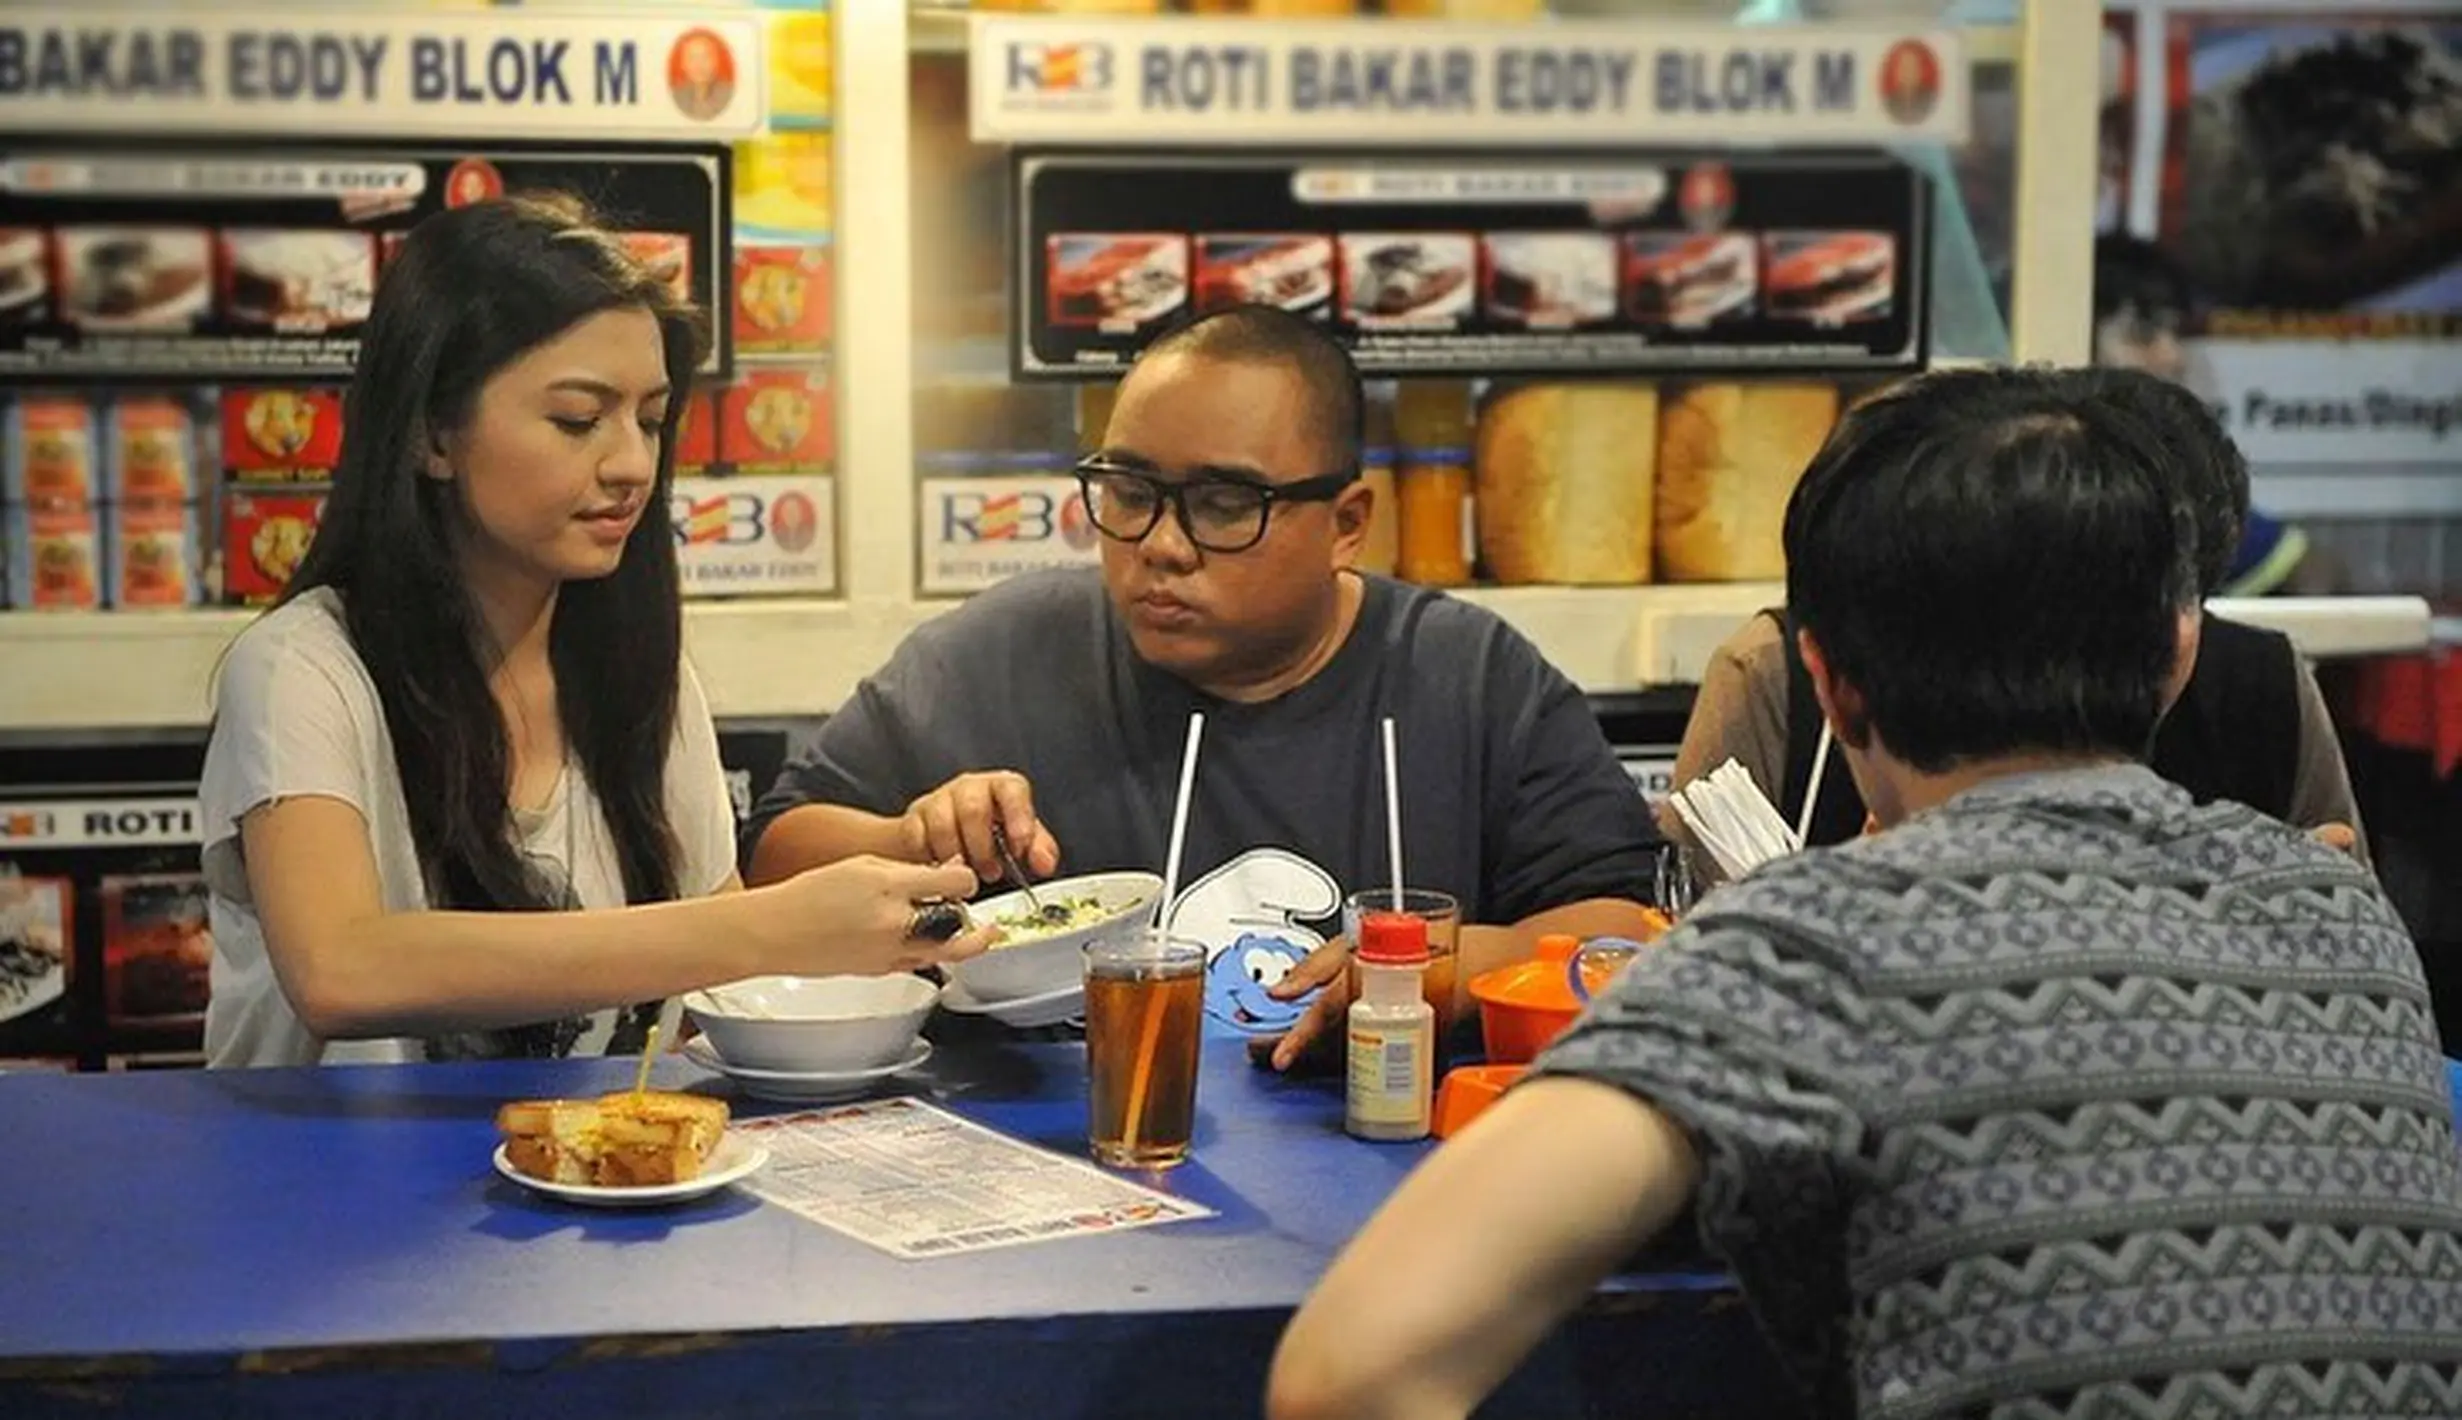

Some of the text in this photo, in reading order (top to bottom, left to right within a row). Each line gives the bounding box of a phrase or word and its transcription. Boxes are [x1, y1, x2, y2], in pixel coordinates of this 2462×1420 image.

[0, 28, 638, 105] BAKAR EDDY BLOK M
[1141, 46, 1856, 114] ROTI BAKAR EDDY BLOK M
[84, 808, 193, 835] ROTI
